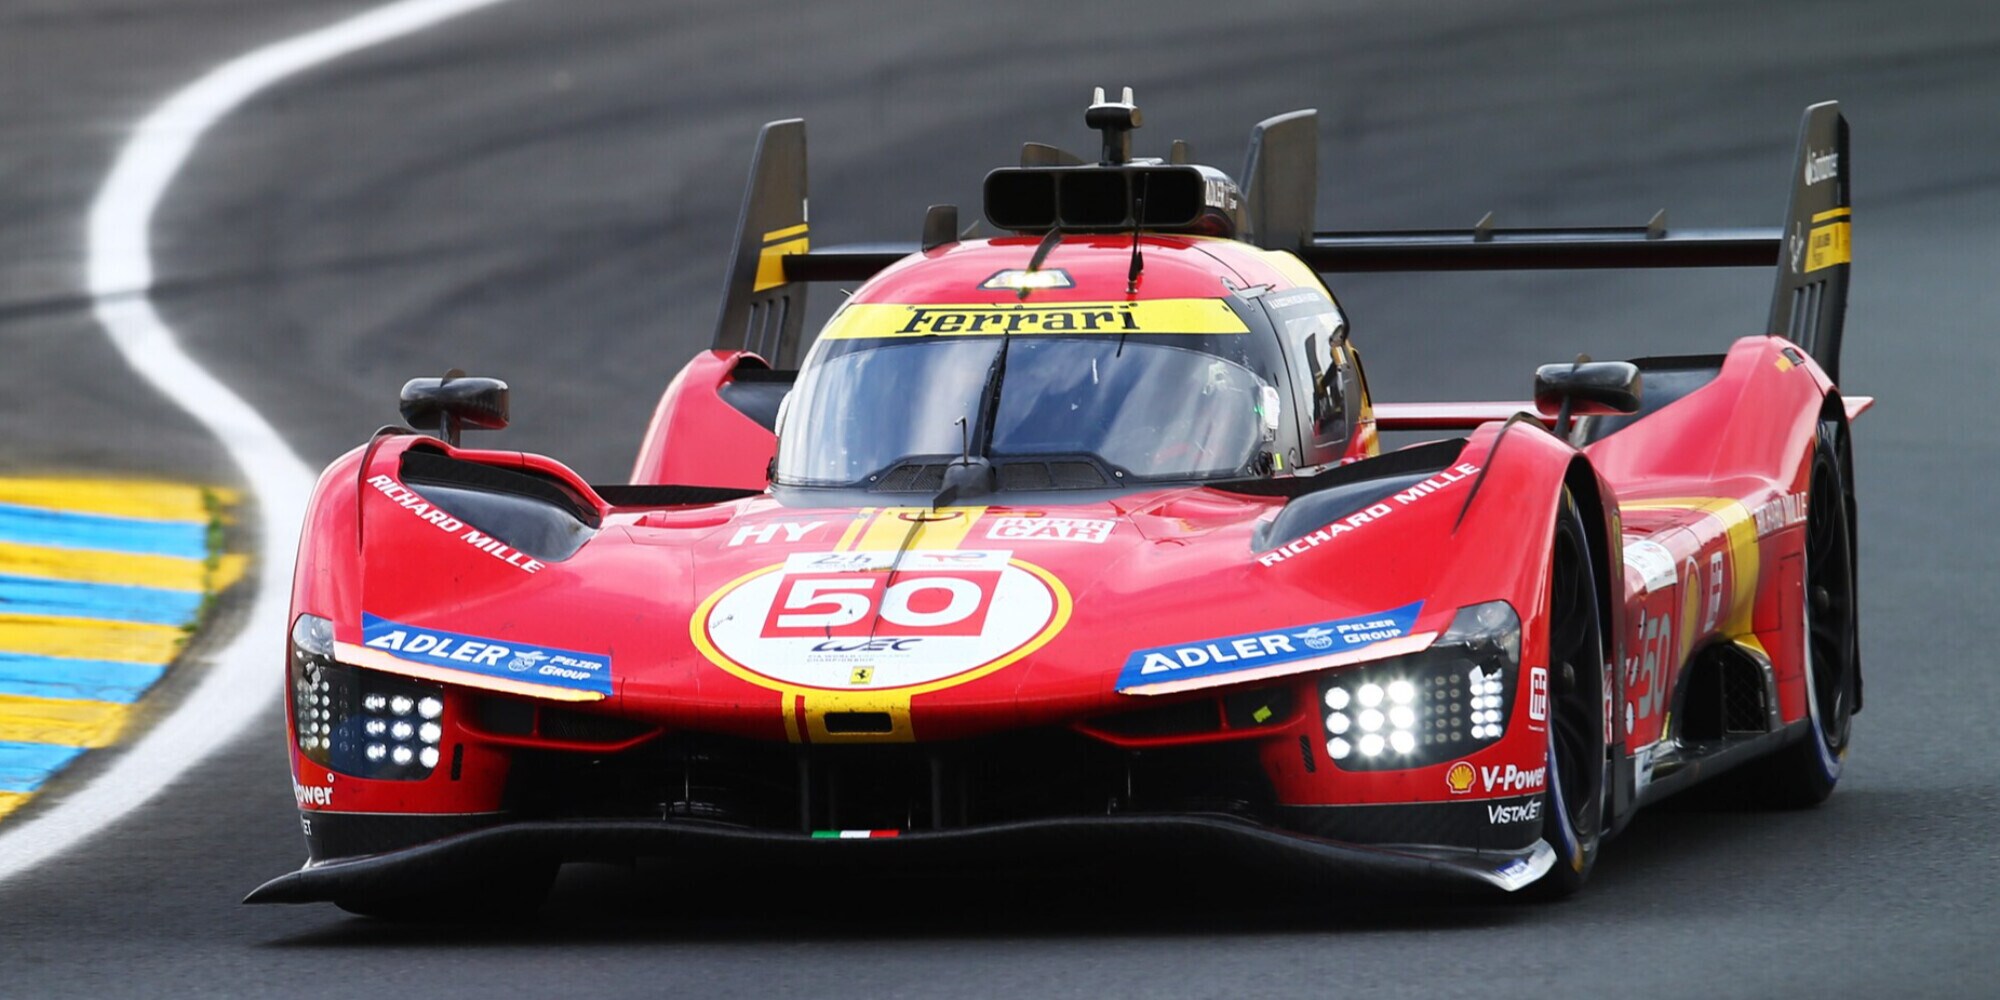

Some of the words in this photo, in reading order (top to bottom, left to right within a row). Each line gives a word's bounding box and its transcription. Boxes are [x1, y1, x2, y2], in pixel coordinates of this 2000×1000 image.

[895, 305, 1140, 334] Ferrari
[367, 474, 462, 532] RICHARD
[461, 529, 546, 574] MILLE
[1259, 502, 1392, 566] RICHARD
[1394, 463, 1480, 504] MILLE
[730, 522, 827, 546] HY
[999, 526, 1099, 540] CAR
[777, 577, 982, 627] 50
[1337, 619, 1396, 633] PELZER
[1344, 628, 1402, 644] GROUP
[365, 630, 510, 666] ADLER
[811, 638, 924, 652] WEC
[1140, 634, 1296, 675] ADLER
[539, 665, 591, 681] GROUP
[553, 655, 602, 671] PELZER
[1639, 613, 1670, 719] 50
[1481, 764, 1546, 792] V-Power
